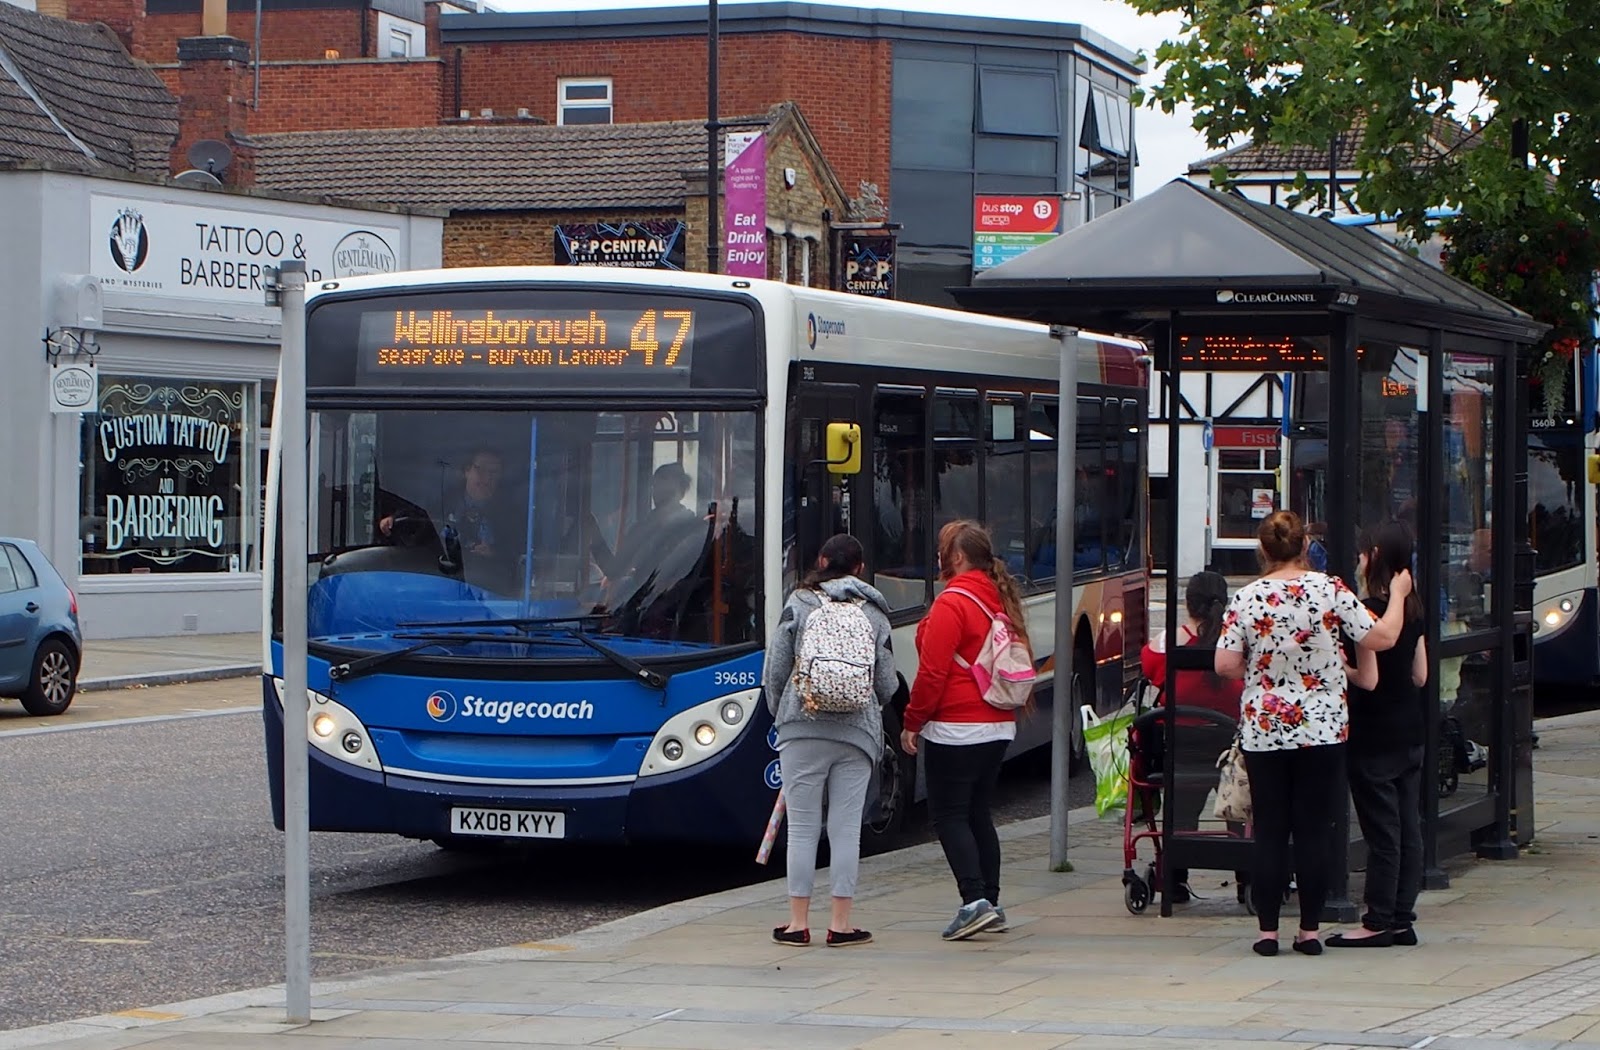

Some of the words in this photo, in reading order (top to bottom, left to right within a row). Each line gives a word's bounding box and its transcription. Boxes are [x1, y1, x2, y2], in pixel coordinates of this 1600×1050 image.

[982, 201, 1000, 213] bus
[1000, 203, 1024, 217] stop
[1036, 205, 1049, 215] 13
[734, 213, 757, 226] Eat
[195, 222, 286, 257] TATTOO
[292, 233, 308, 260] &
[357, 236, 370, 249] The
[727, 230, 764, 244] Drink
[601, 240, 665, 253] CENTRAL
[981, 246, 994, 255] 49
[337, 247, 391, 273] GENTLEMAN'S
[727, 248, 765, 265] Enjoy
[981, 257, 994, 266] 50
[123, 279, 163, 289] MYSTERIES
[846, 280, 889, 291] CENTRAL
[818, 315, 846, 339] Stagecoach
[629, 309, 693, 367] 47
[488, 348, 553, 366] Burton
[558, 348, 630, 366] Latimer
[1532, 418, 1556, 428] 15608
[99, 415, 167, 462] CUSTOM
[170, 414, 229, 464] TATTOO
[158, 477, 174, 494] AND
[106, 493, 225, 551] BARBERING
[714, 670, 757, 686] 39685
[460, 694, 595, 725] Stagecoach
[458, 809, 512, 833] KX08
[515, 811, 557, 835] KYY
